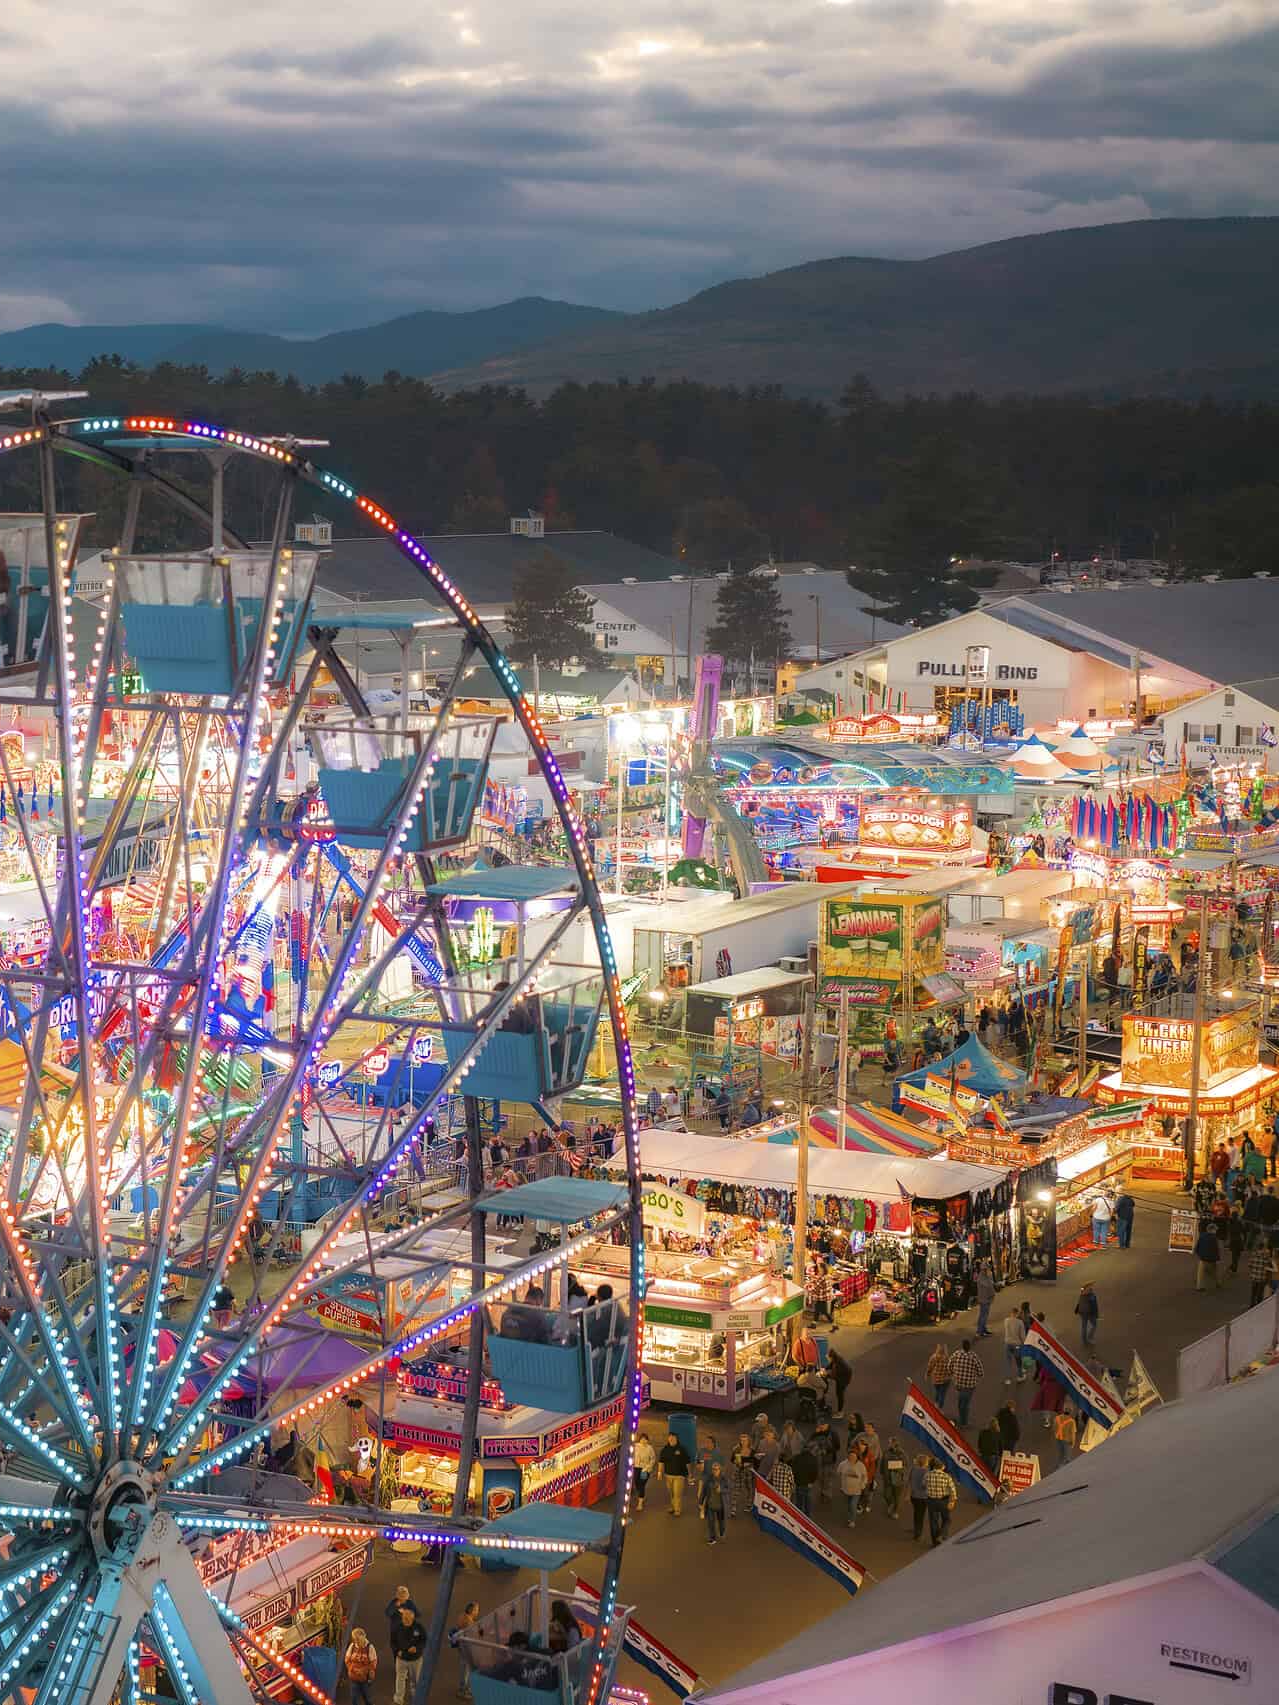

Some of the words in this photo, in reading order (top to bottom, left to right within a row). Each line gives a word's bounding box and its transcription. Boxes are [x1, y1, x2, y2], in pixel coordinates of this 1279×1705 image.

[595, 622, 637, 632] CENTER
[998, 664, 1038, 680] RING
[864, 812, 899, 823] FRIED
[901, 813, 945, 829] DOUGH
[1113, 866, 1167, 881] POPCORN
[832, 911, 899, 937] LEMONADE
[1139, 1038, 1194, 1055] FINGER
[1172, 1223, 1193, 1235] PIZZA
[324, 1307, 361, 1328] PUPPIES
[330, 1302, 358, 1320] SLUSH
[403, 1373, 459, 1395] DOUGH
[1037, 1338, 1107, 1411] BINGO
[553, 1415, 599, 1444] FRIED
[911, 1405, 987, 1483] BINGO
[761, 1500, 850, 1572] BINGO
[1160, 1643, 1248, 1673] RESTROOM
